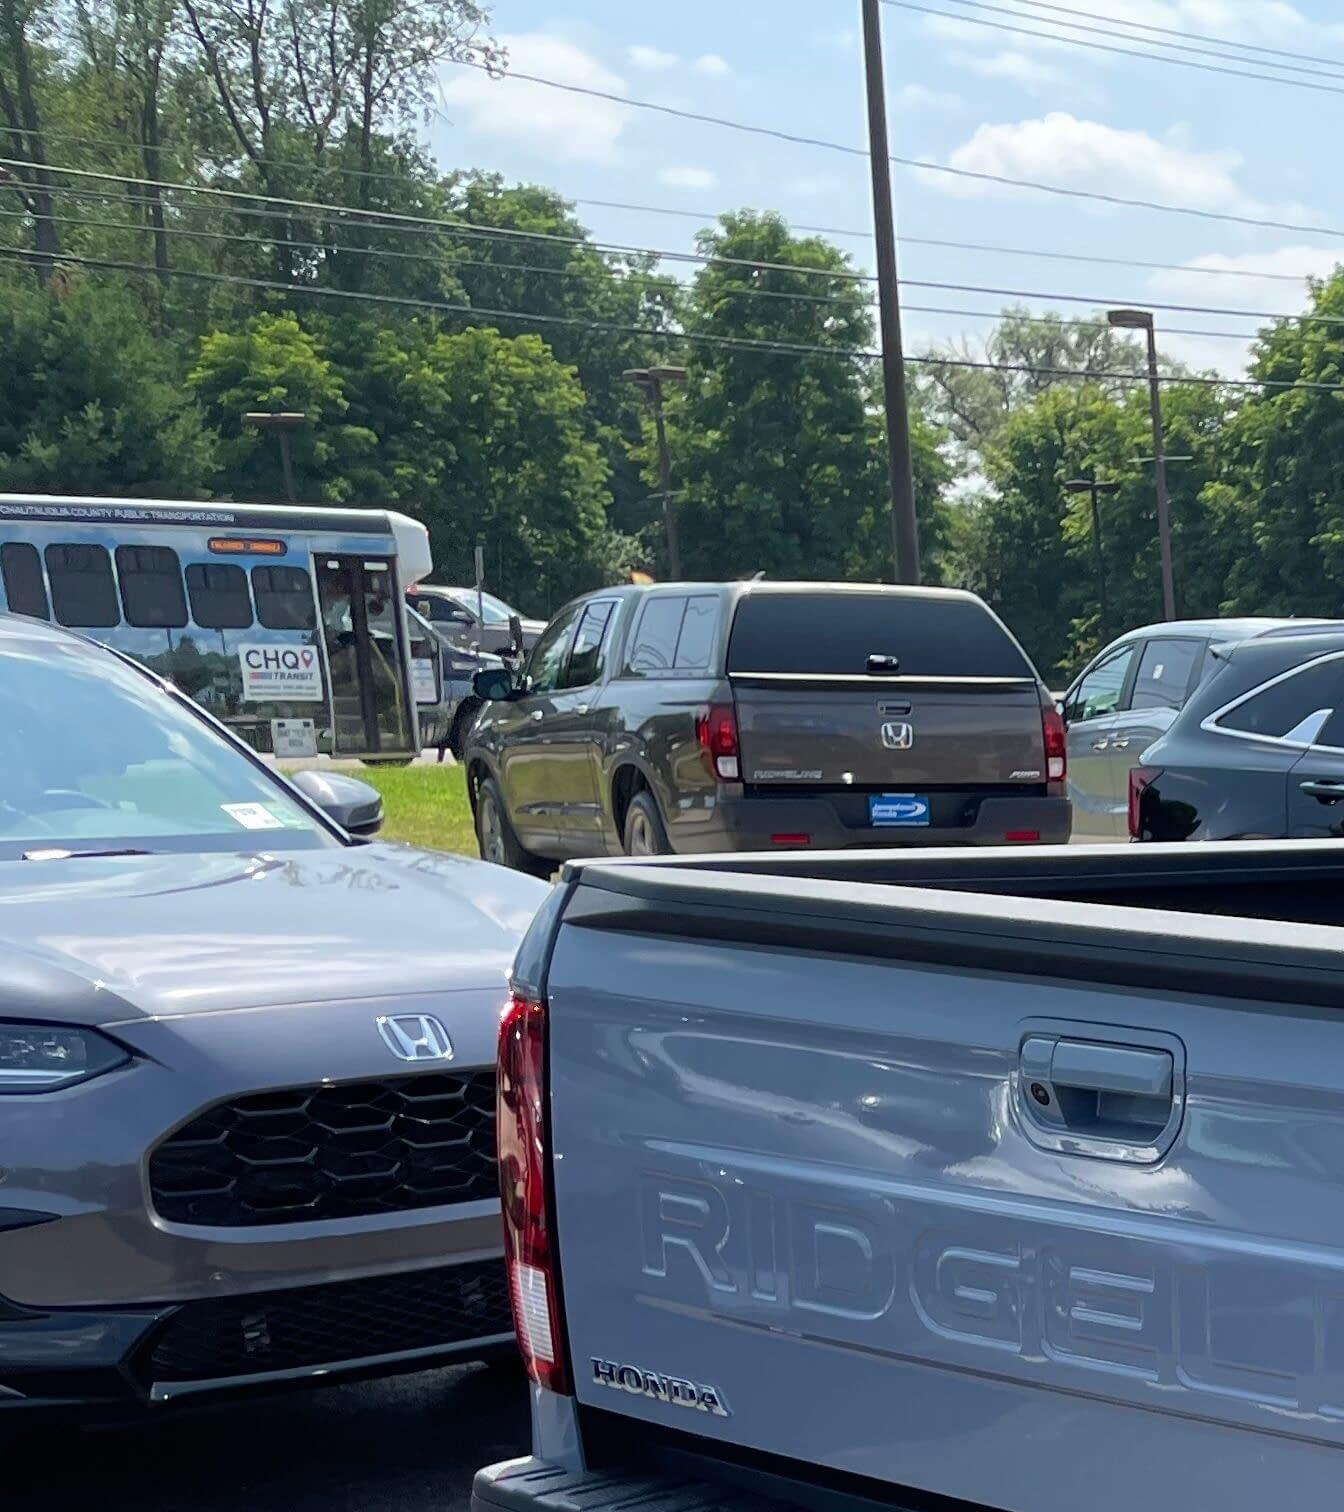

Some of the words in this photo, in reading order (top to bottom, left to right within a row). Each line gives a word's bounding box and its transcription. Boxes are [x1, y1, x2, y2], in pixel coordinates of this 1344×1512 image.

[72, 507, 112, 518] COUNTY
[114, 509, 147, 519] PUBLIC
[150, 511, 235, 523] TRANSPORTATION
[246, 649, 299, 669] CHQ
[274, 671, 313, 680] TRANSIT
[590, 1356, 733, 1417] HONDA
